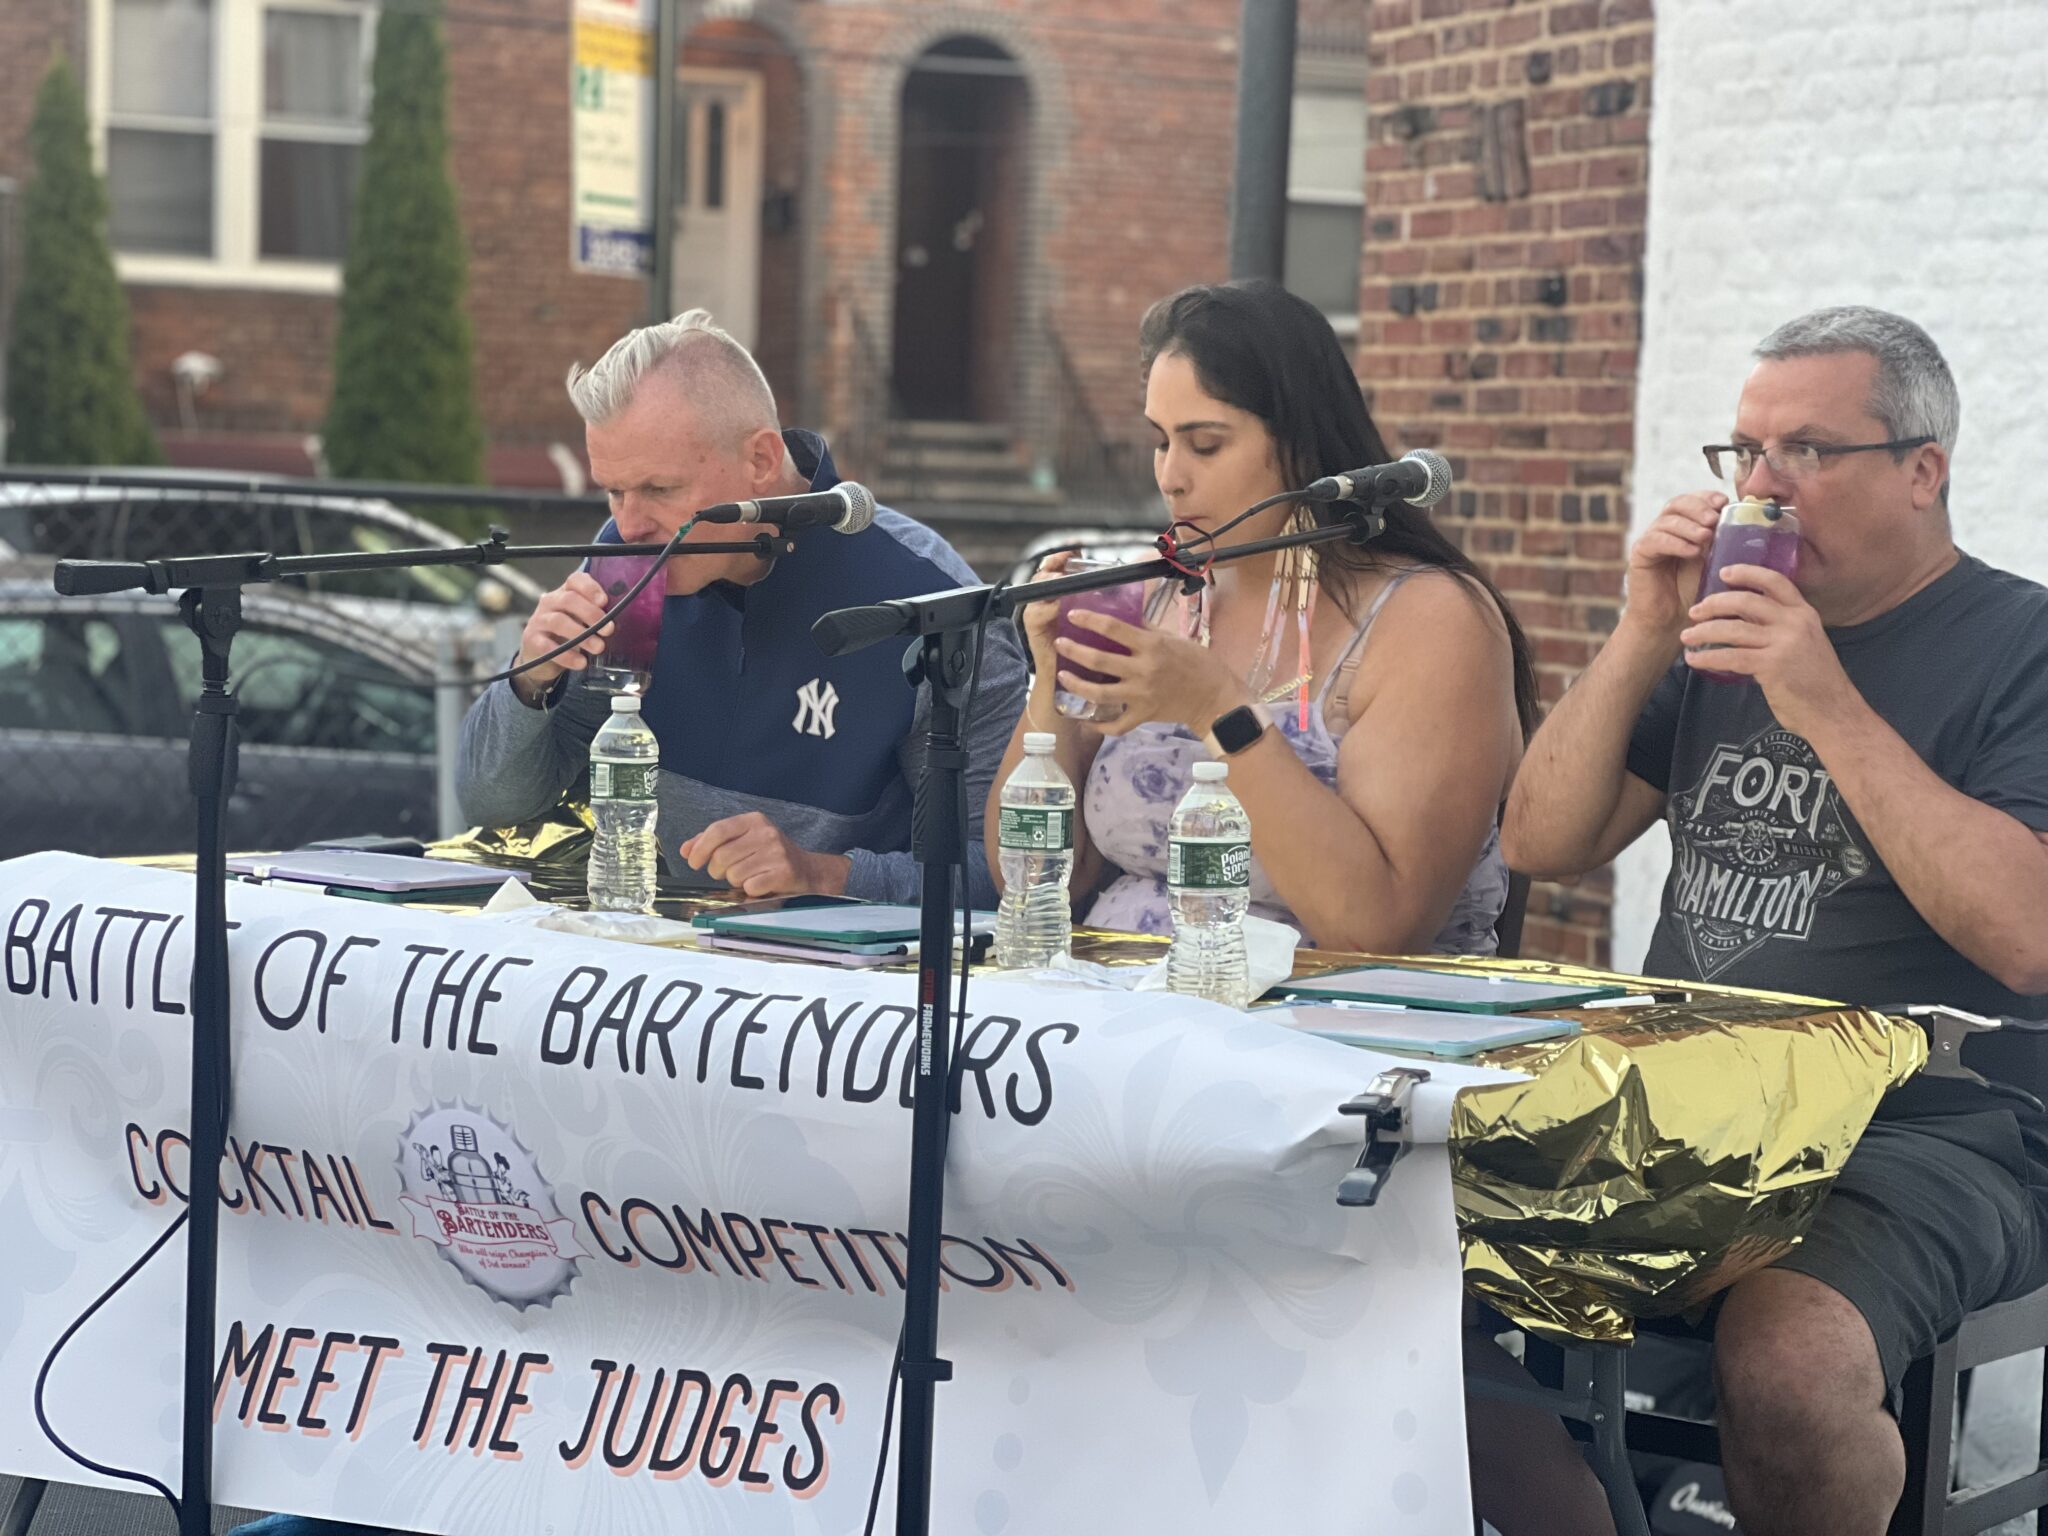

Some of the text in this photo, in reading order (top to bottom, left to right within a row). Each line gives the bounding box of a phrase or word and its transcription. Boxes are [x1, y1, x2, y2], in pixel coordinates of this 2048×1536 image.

[791, 677, 840, 740] NY
[1689, 751, 1832, 841] FORT
[1221, 850, 1250, 868] Polan
[1222, 861, 1250, 881] Sprin
[1674, 836, 1826, 932] HAMILTON
[254, 929, 380, 1034] OF
[391, 943, 534, 1056] THE
[921, 1003, 934, 1076] FRAMEWORKS
[437, 1209, 549, 1241] BARTENDERS
[455, 1201, 520, 1221] BATTLE OF THE
[213, 1320, 843, 1496] MEET THE JUDGES
